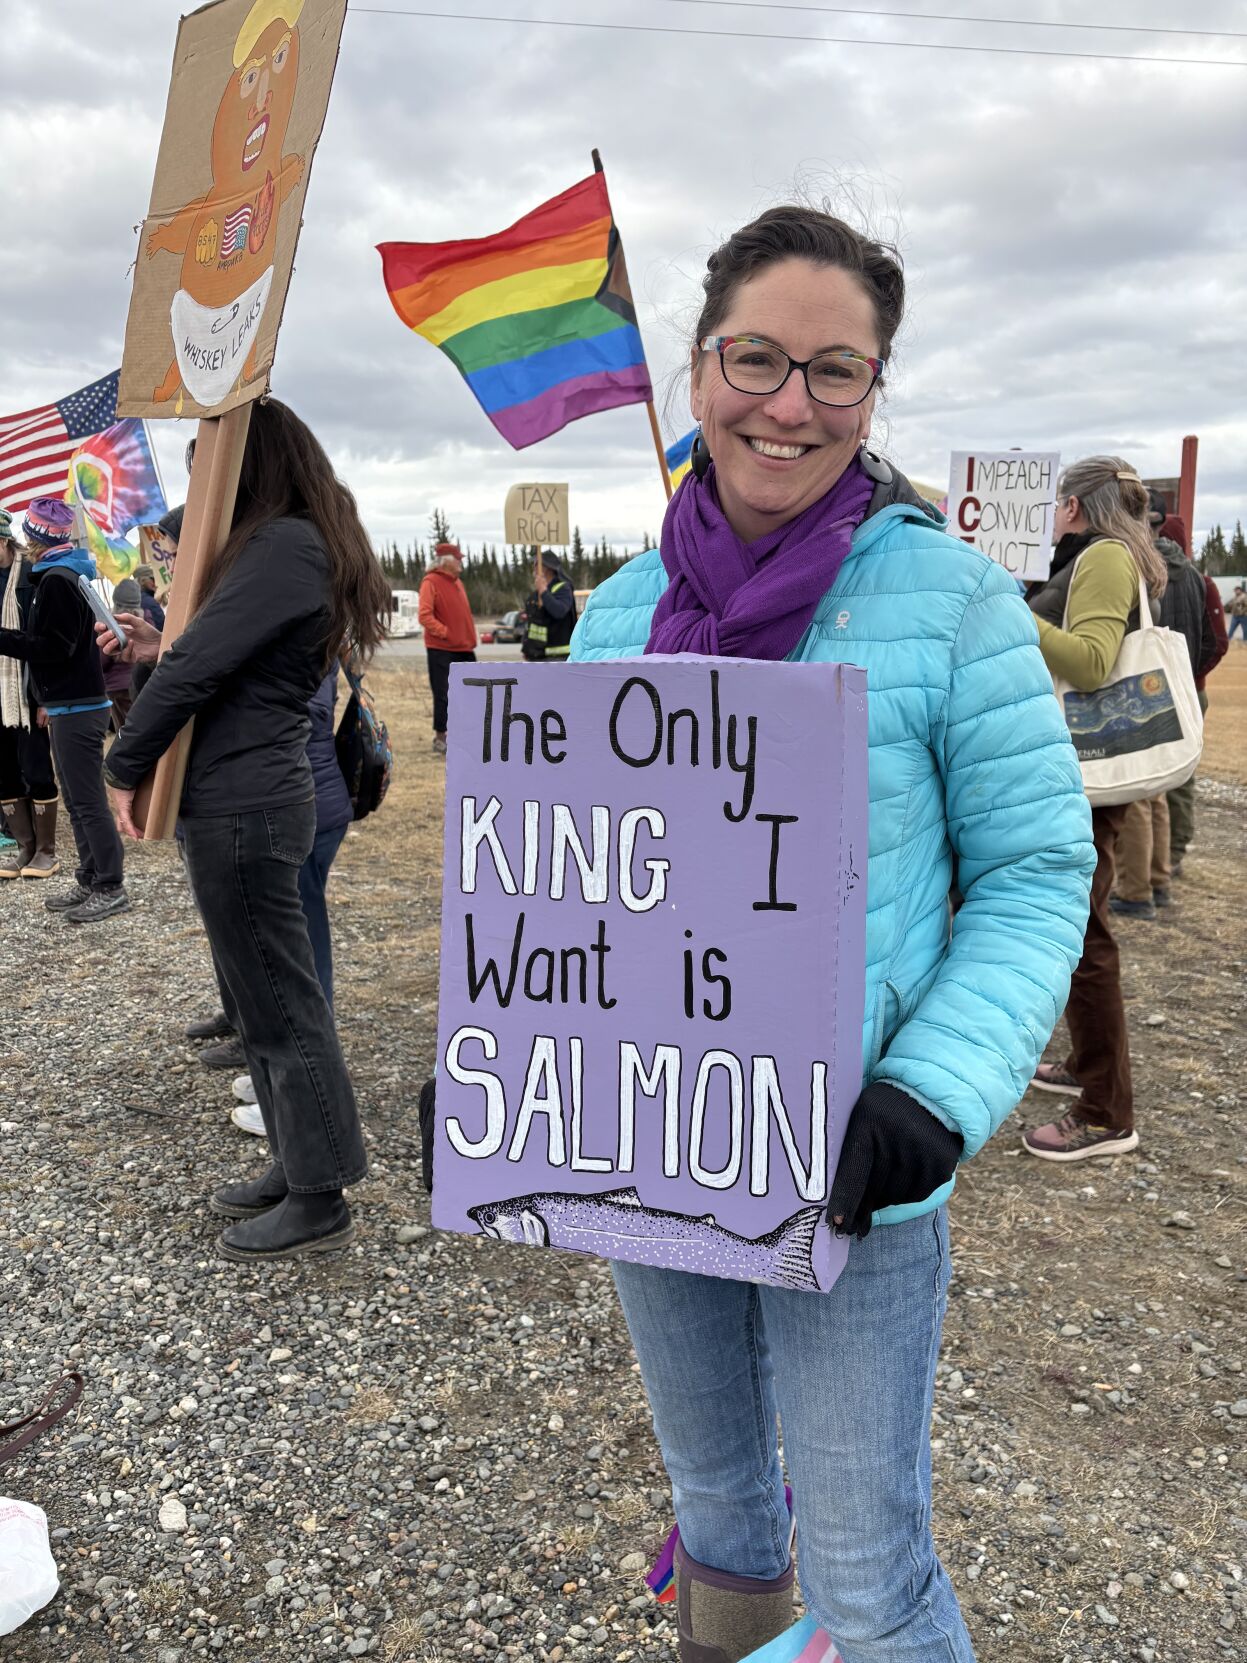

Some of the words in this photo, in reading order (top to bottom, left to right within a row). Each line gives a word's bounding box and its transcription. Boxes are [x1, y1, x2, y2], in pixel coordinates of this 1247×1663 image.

[183, 335, 228, 371] WHISKEY
[231, 292, 262, 359] LEAKS
[516, 486, 559, 513] TAX
[966, 456, 1052, 493] IMPEACH
[516, 516, 560, 543] RICH
[957, 495, 1053, 536] CONVICT
[960, 536, 1041, 574] VICT
[462, 677, 567, 765] The
[608, 669, 759, 823] Only
[460, 796, 670, 913] KING
[751, 812, 799, 912] I
[463, 911, 618, 1010] Want
[683, 929, 733, 1022] is
[444, 1025, 828, 1202] SALMON
